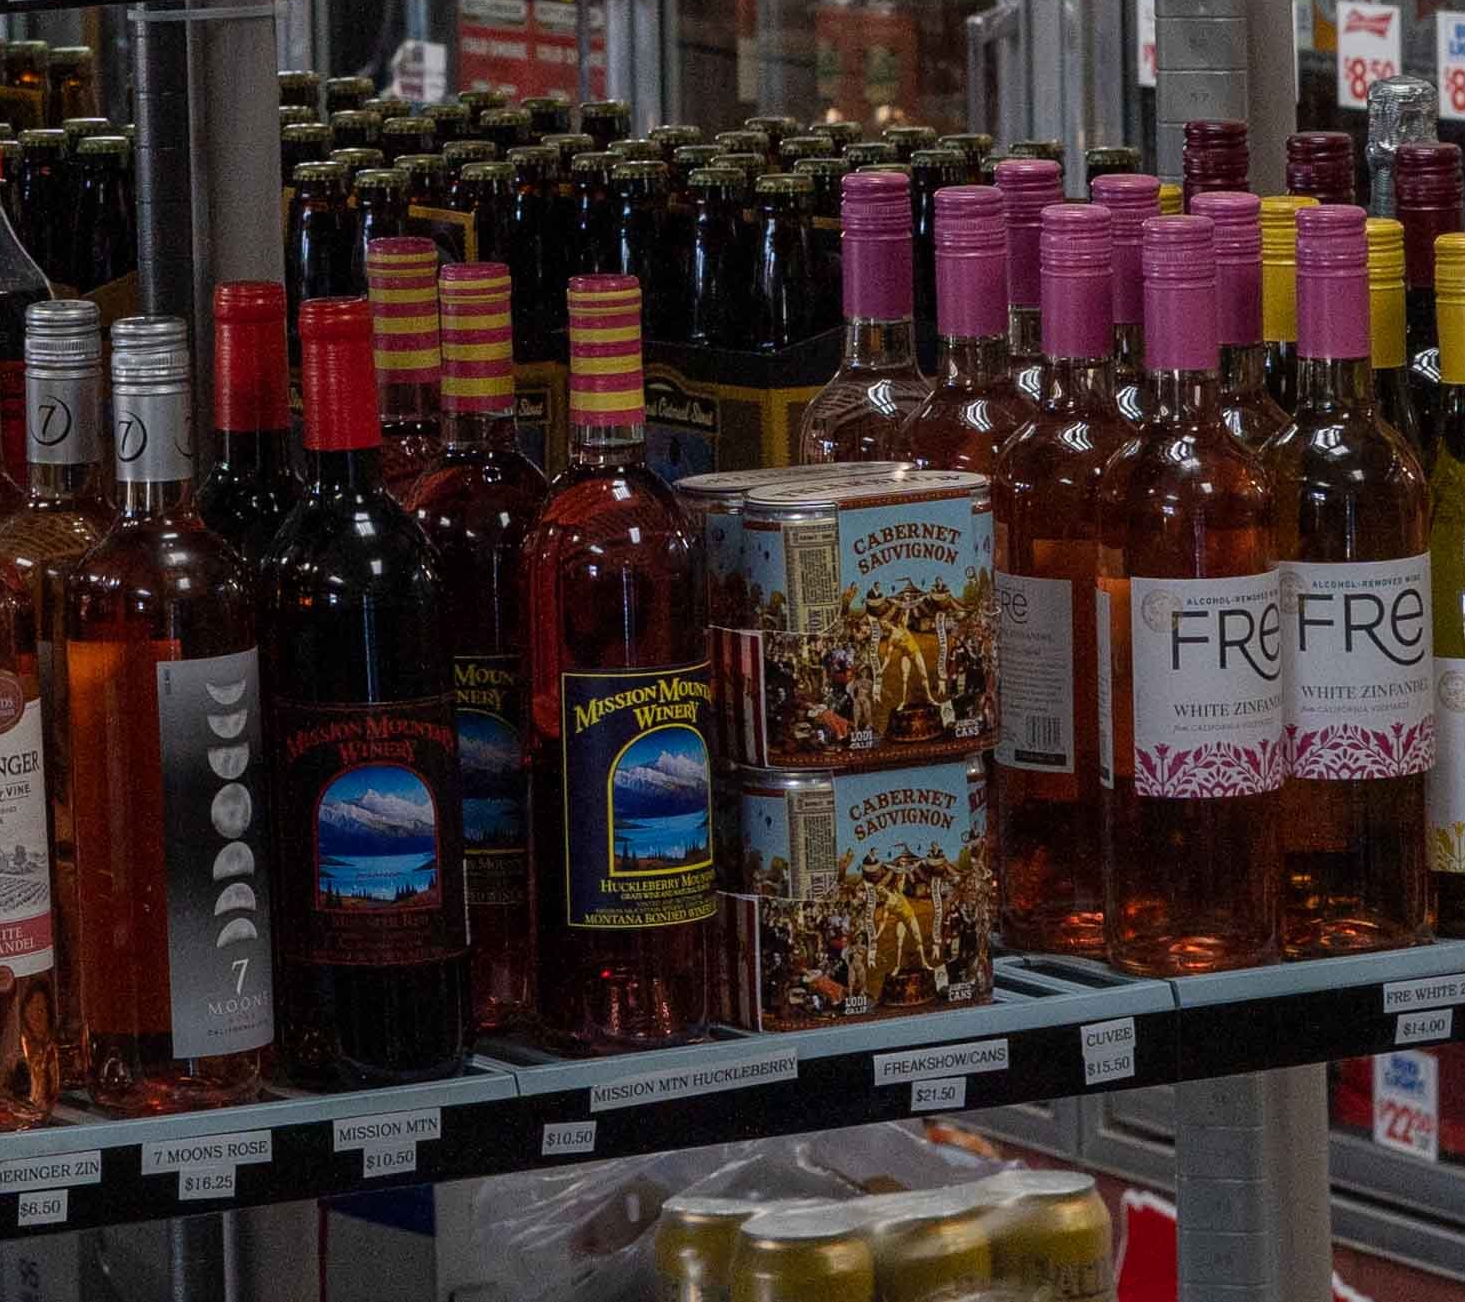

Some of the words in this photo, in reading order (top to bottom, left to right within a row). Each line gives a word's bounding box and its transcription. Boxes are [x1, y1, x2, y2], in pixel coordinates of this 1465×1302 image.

[853, 522, 962, 556] CABERNET
[859, 543, 960, 576] SAUVIGNON
[1301, 683, 1356, 701] WHITE
[575, 683, 657, 734] MISSION
[634, 702, 700, 729] WINERY
[6, 784, 32, 798] VINE
[849, 787, 958, 823] CABERNET
[854, 808, 955, 842] SAUVIGNON
[601, 878, 680, 895] HUCKLEBERRY
[232, 957, 250, 995] 7
[1386, 989, 1410, 1007] FRE
[1414, 984, 1455, 1004] WHITE
[1085, 1026, 1133, 1047] CUVEE
[1402, 1018, 1446, 1036] $14.00
[1086, 1055, 1131, 1076] $15.50
[593, 1081, 656, 1105] MISSION
[659, 1075, 689, 1092] MTN
[692, 1056, 797, 1089] HUCKLEBERRY
[916, 1084, 957, 1103] $21.50
[338, 1124, 398, 1143] MISSION
[406, 1120, 438, 1138] MTN
[545, 1130, 593, 1148] $10.50
[154, 1149, 161, 1165] 7
[167, 1145, 223, 1165] MOONS
[228, 1140, 269, 1160] ROSE
[366, 1149, 415, 1170] $10.50
[75, 1158, 100, 1178] ZIN
[184, 1174, 233, 1194] $16.25
[19, 1199, 62, 1218] $6.50
